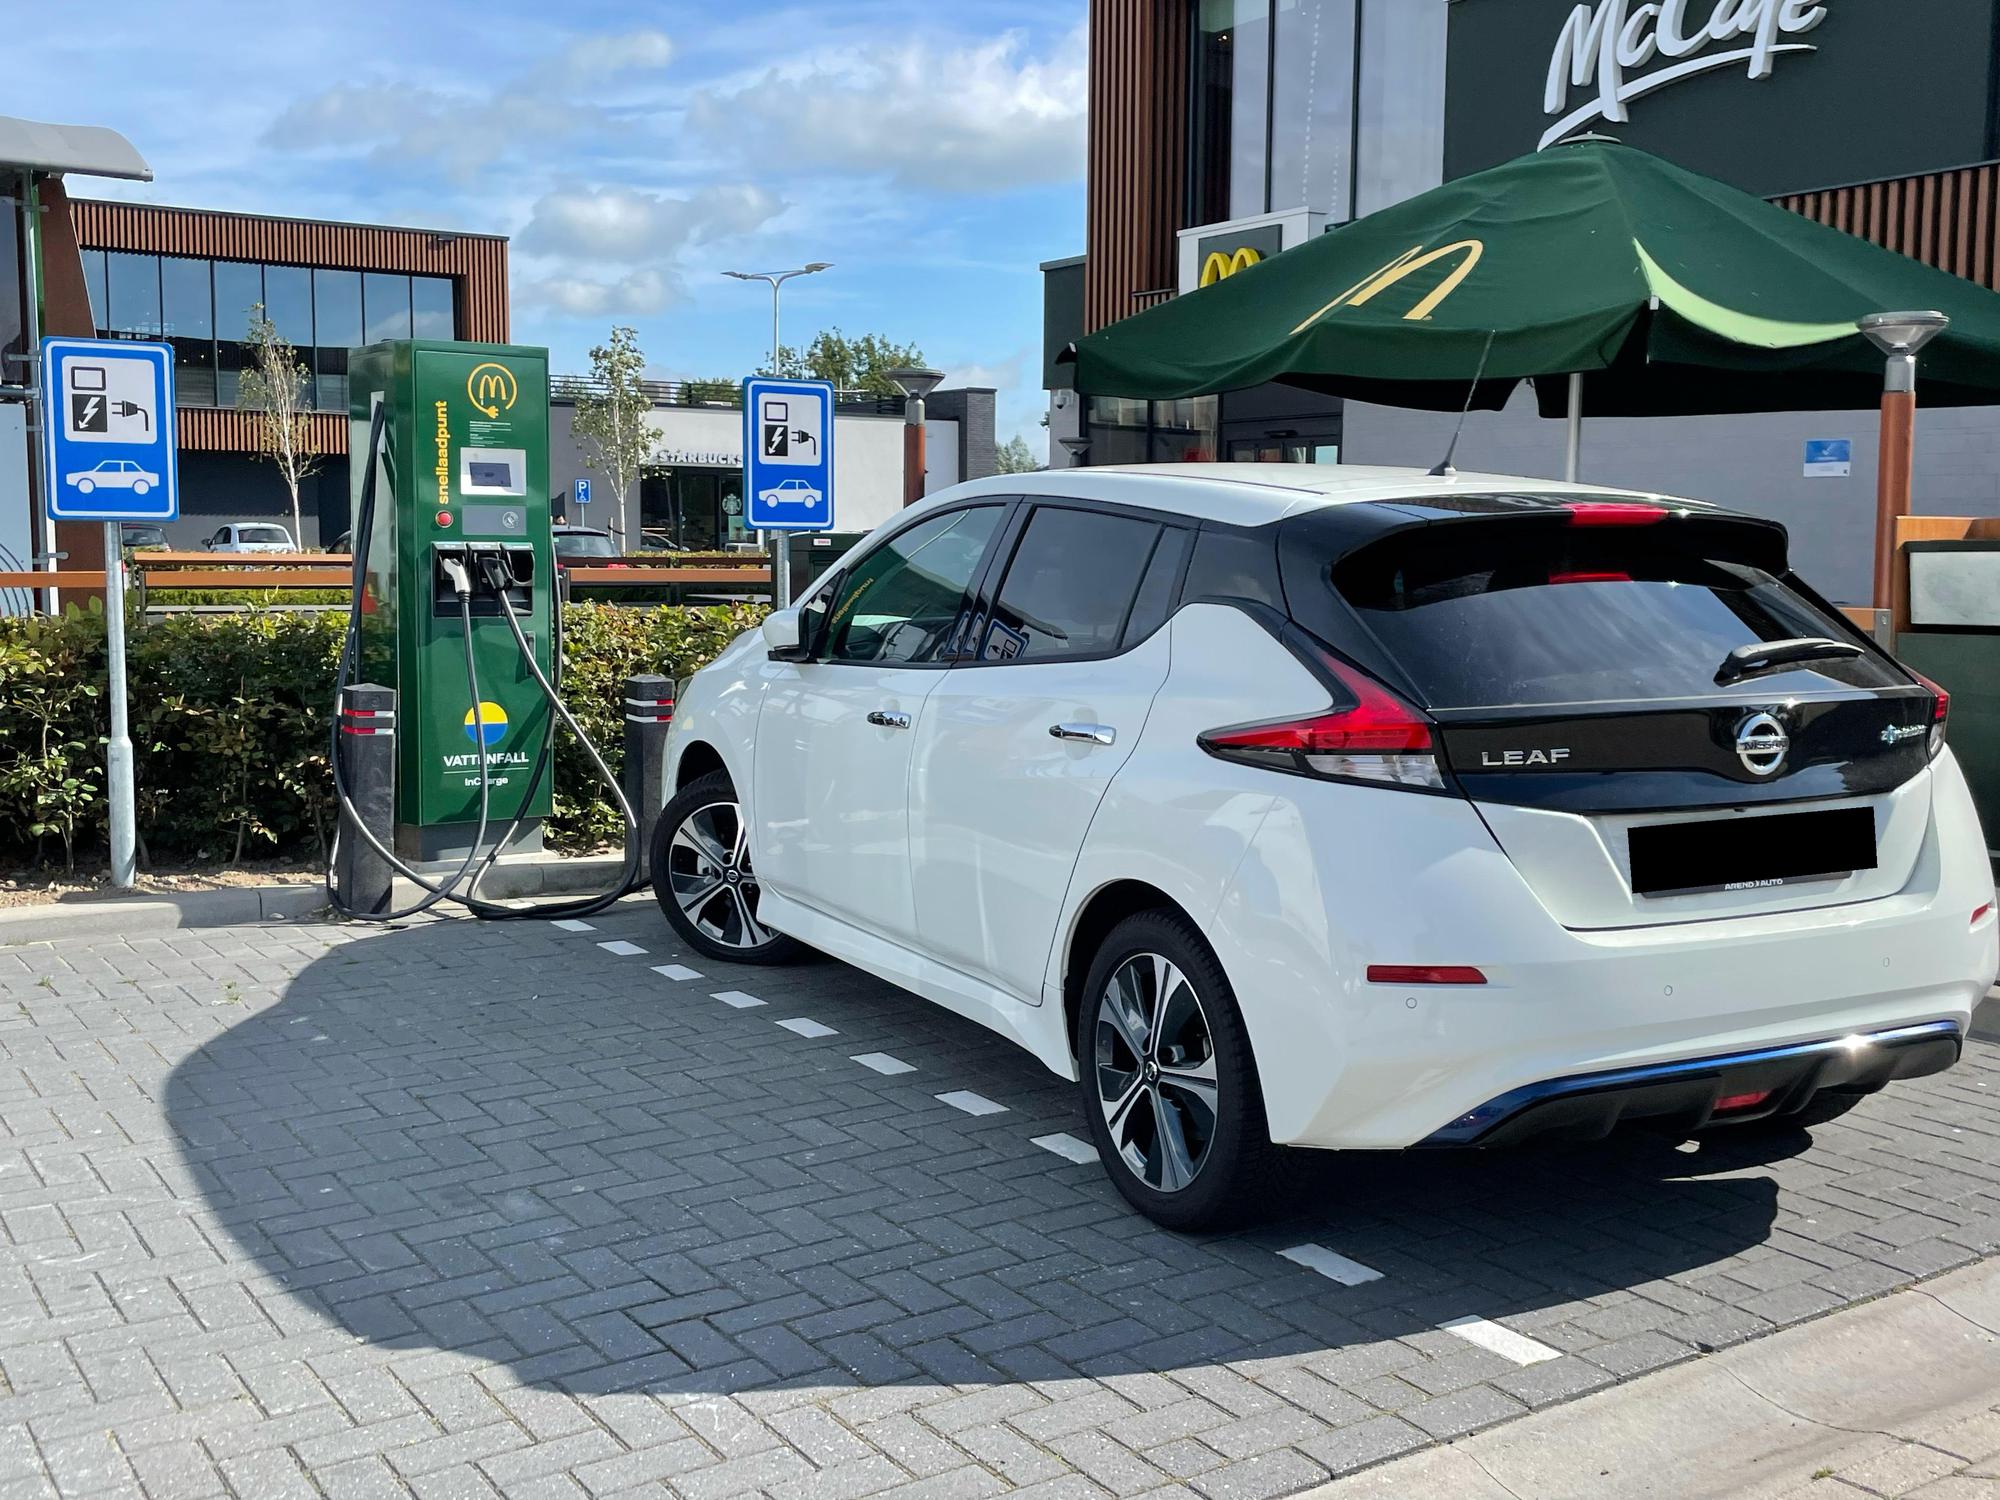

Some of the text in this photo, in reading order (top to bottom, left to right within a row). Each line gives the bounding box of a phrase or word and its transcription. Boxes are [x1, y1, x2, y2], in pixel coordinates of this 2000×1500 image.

[435, 400, 451, 505] snellaadpunt
[578, 481, 587, 493] P
[443, 752, 529, 767] VATTNFALL
[1482, 748, 1571, 766] LEAF
[464, 776, 509, 787] InCarge
[1724, 878, 1783, 890] AREND AUTO
